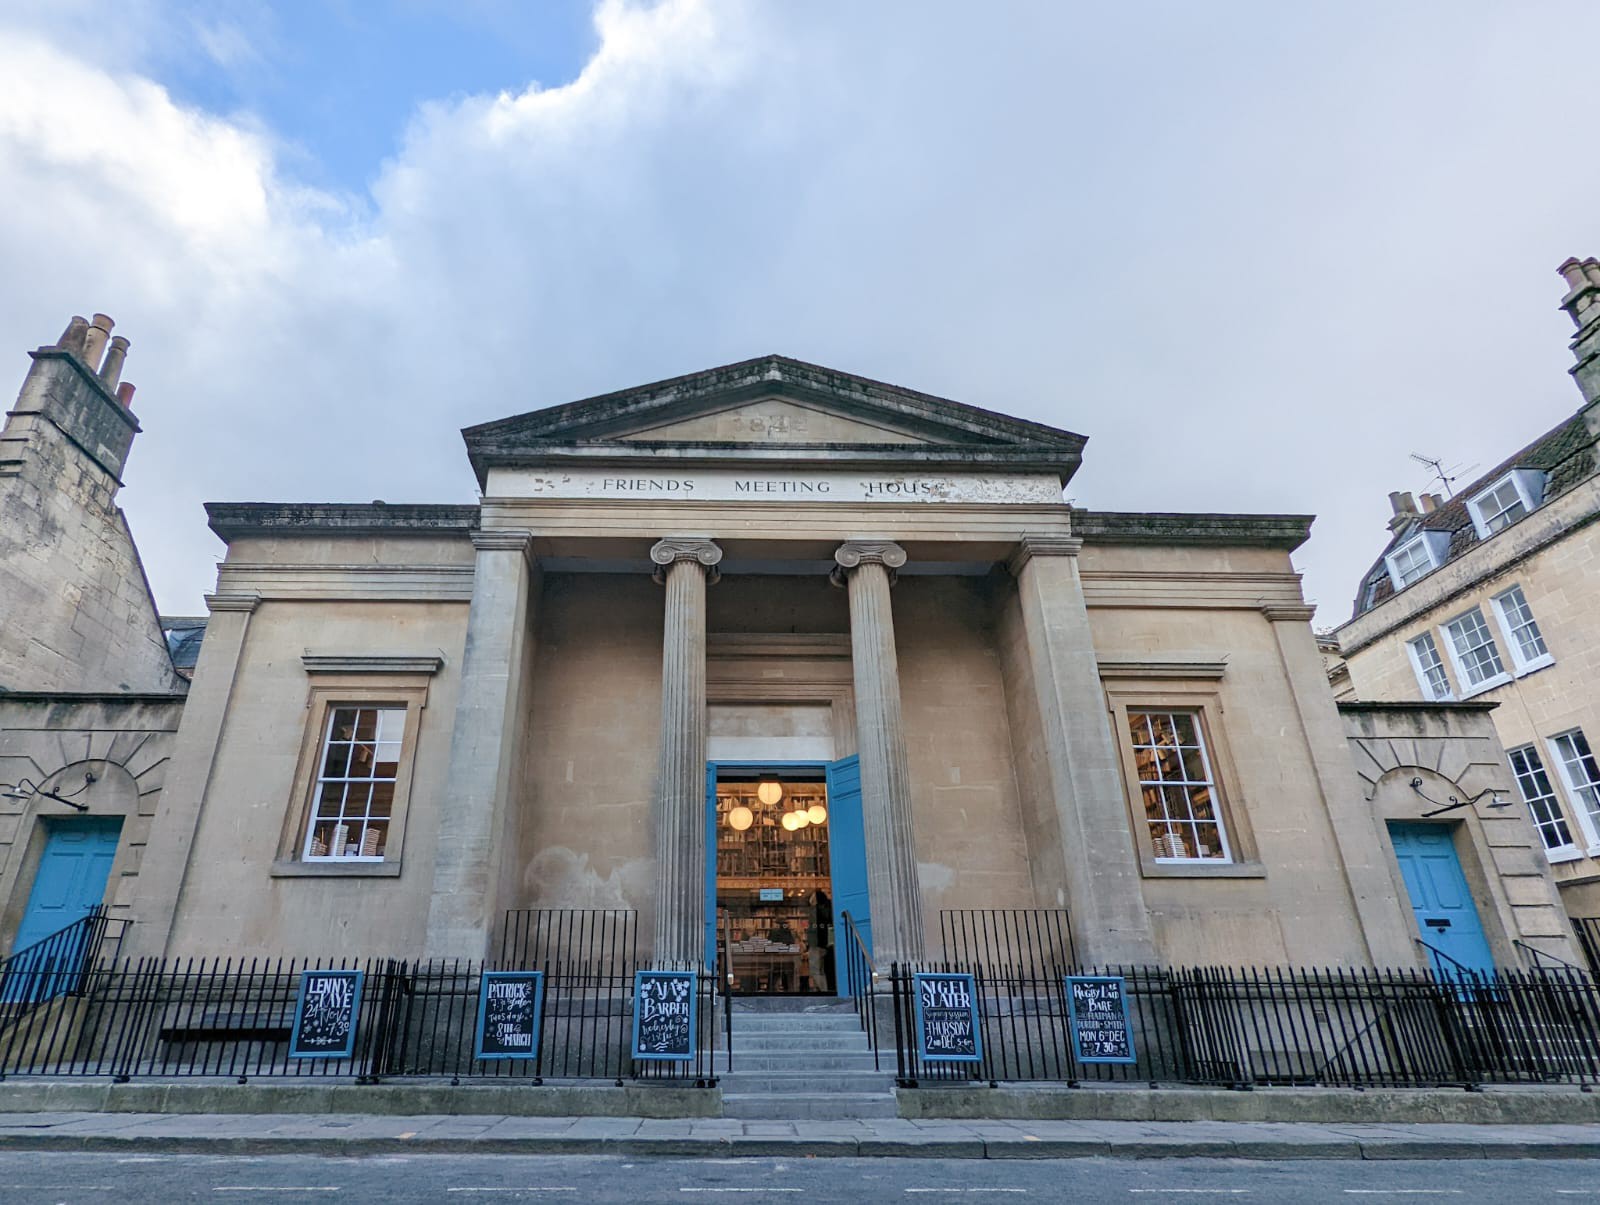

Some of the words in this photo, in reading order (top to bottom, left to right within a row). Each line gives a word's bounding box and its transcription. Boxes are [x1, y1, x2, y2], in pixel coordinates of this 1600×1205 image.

[603, 478, 695, 492] FRIENDS
[735, 480, 831, 494] MEETING
[309, 978, 352, 994] LENNY
[487, 983, 527, 998] PATRICK
[920, 980, 965, 995] NIGEL
[319, 992, 353, 1008] KAYE
[922, 993, 971, 1008] SLATER
[1088, 999, 1113, 1012] BARE
[643, 998, 689, 1019] BARBER
[926, 1021, 970, 1037] THURSDAY
[1079, 1030, 1097, 1042] MON
[1109, 1030, 1125, 1042] DEC
[503, 1033, 532, 1047] MARCH
